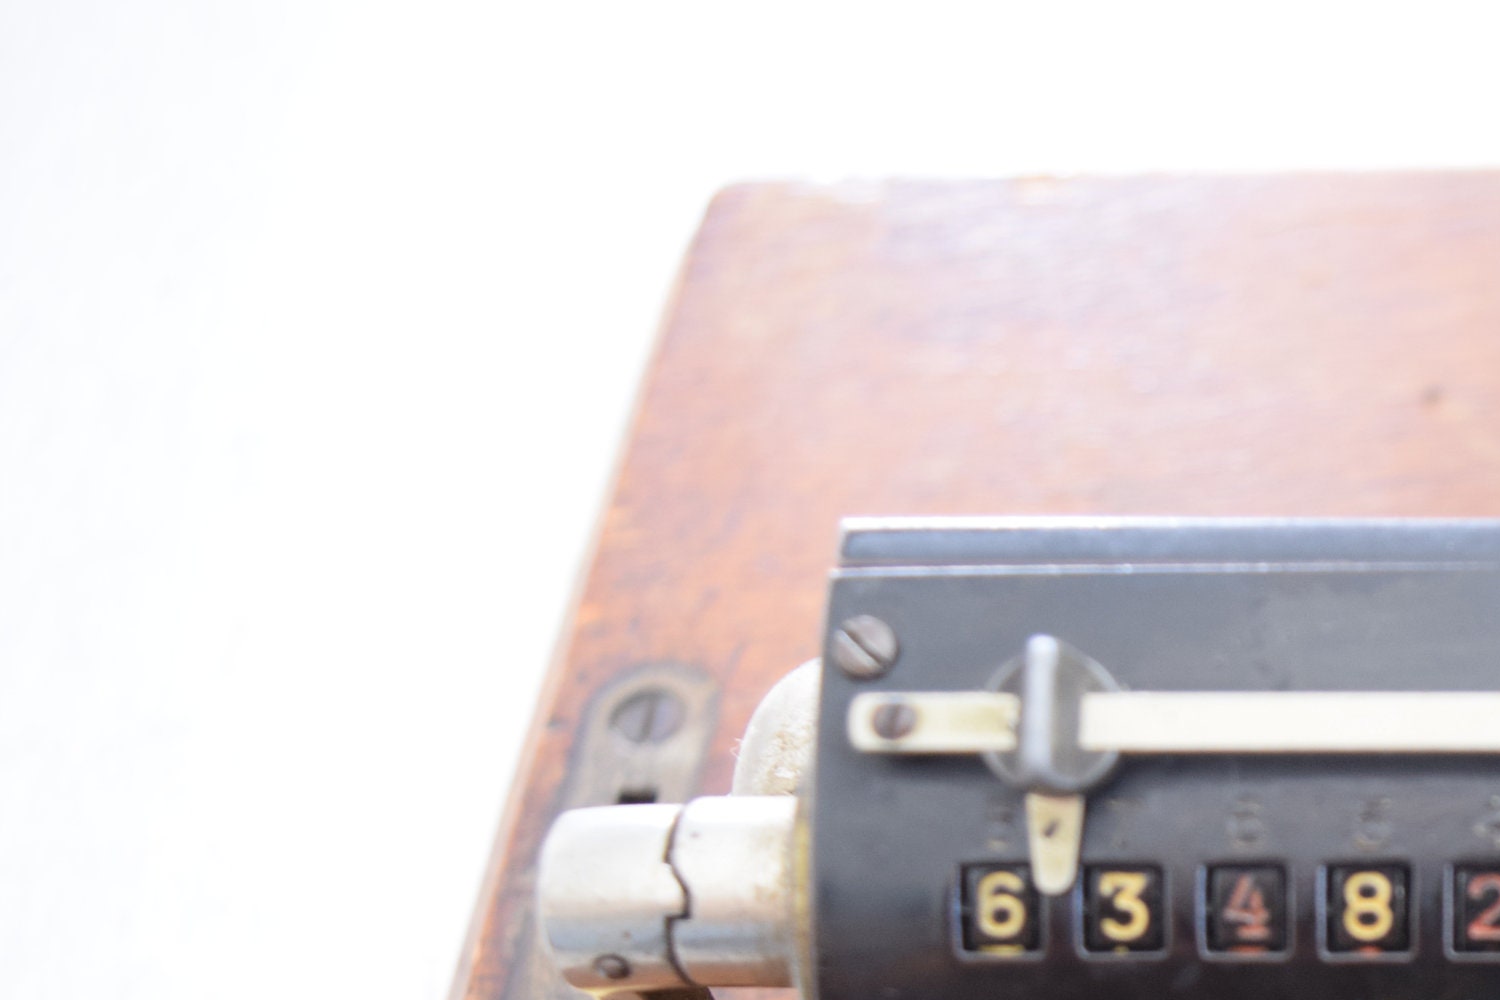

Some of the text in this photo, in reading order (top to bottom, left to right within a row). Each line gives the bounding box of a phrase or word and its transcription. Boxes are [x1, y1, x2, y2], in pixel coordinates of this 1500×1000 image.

[976, 871, 1026, 941] 6
[1098, 871, 1151, 942] 3
[1222, 874, 1272, 940] 4
[1341, 871, 1394, 942] 8
